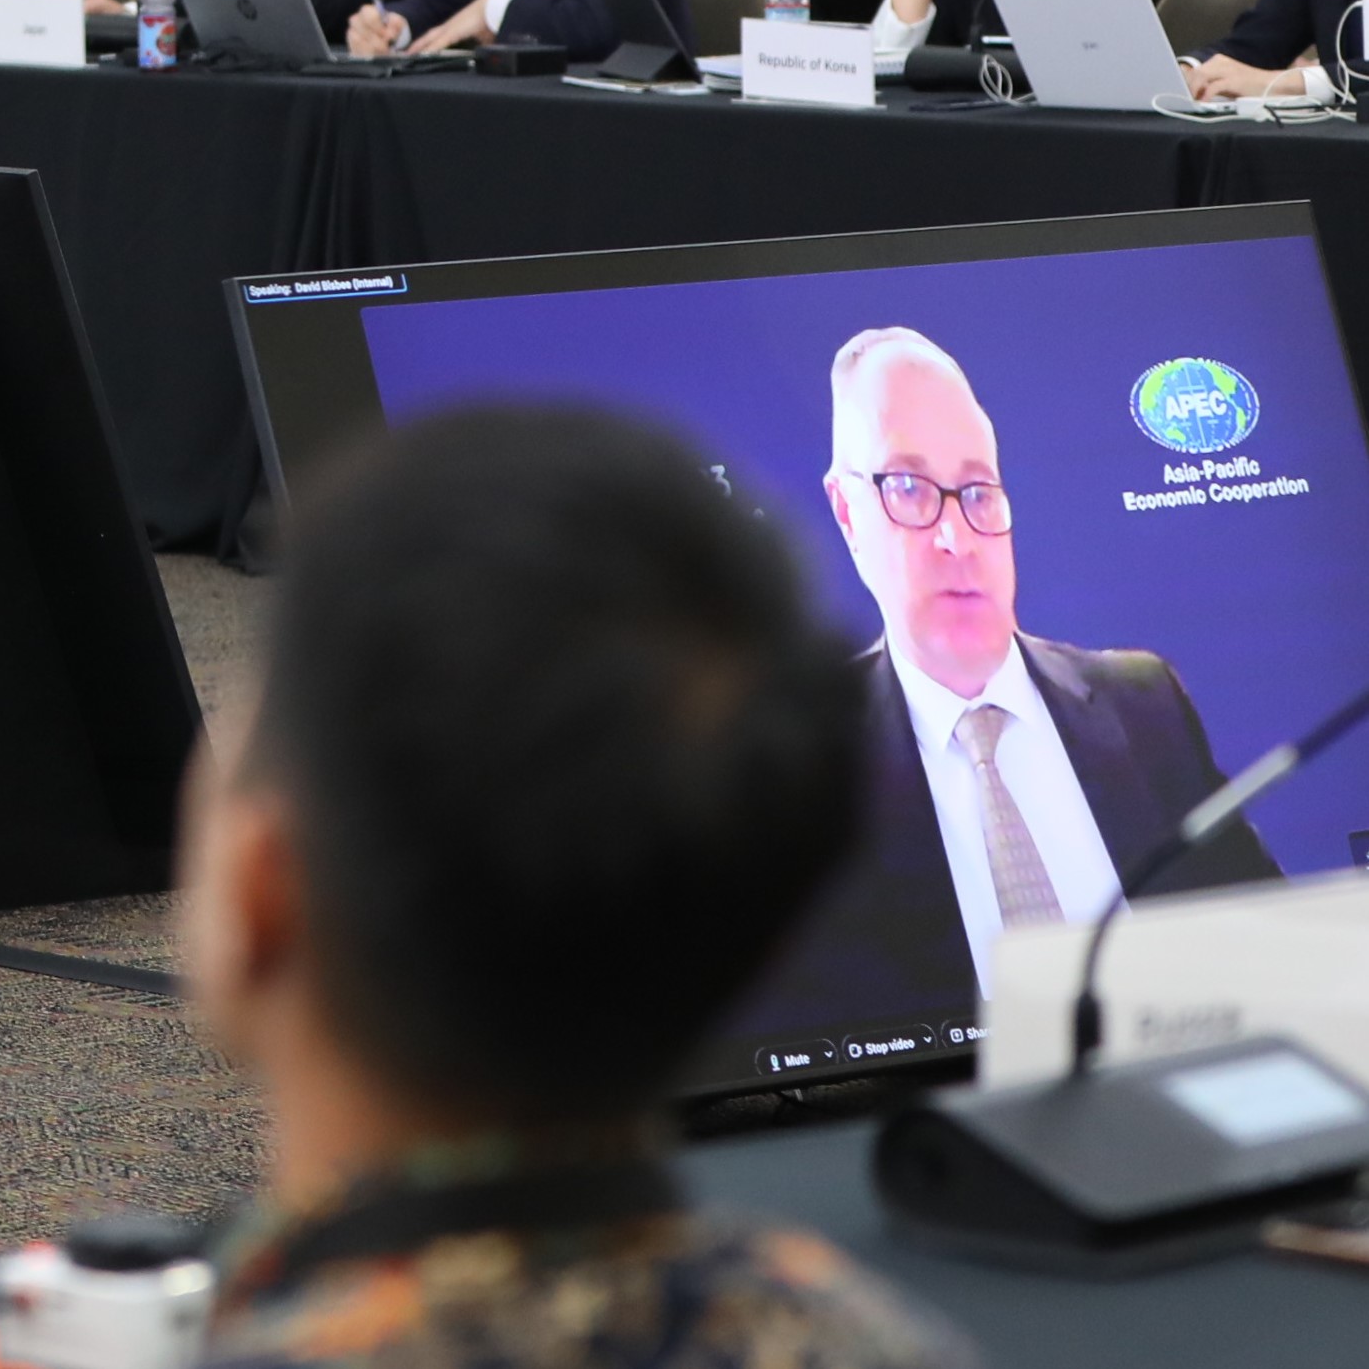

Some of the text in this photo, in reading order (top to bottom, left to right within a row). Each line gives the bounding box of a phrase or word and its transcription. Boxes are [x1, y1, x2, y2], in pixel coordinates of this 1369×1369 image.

[758, 52, 858, 74] Republic of Korea
[249, 284, 292, 297] Speaking:
[294, 281, 321, 294] David
[321, 279, 352, 292] Bisbee
[1164, 390, 1228, 421] APEC
[1163, 456, 1261, 485] Asia-Pacific
[1122, 476, 1310, 511] Economic Cooperation
[865, 1037, 916, 1057] Stop video
[784, 1053, 811, 1068] Mute
